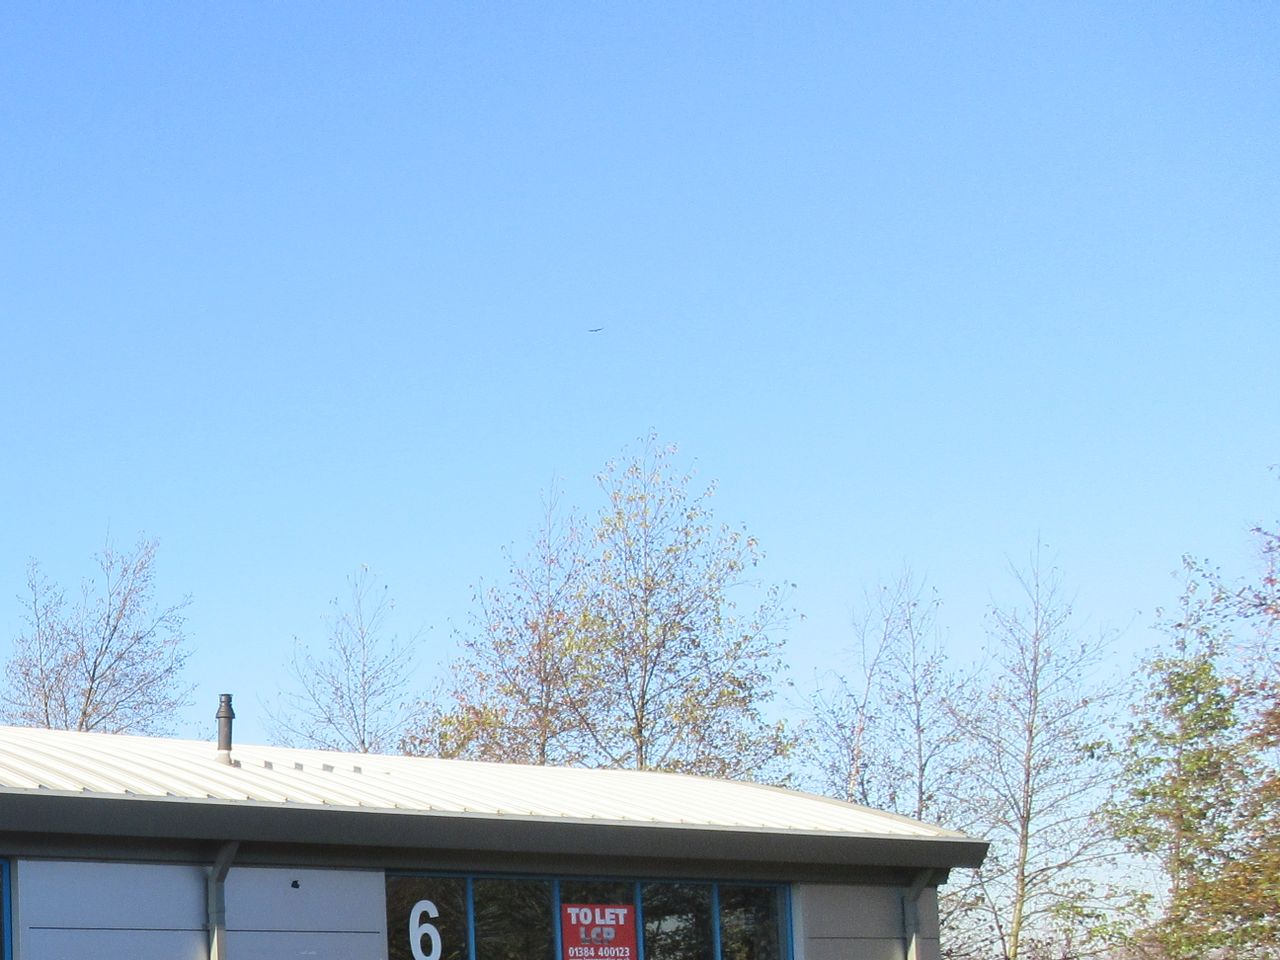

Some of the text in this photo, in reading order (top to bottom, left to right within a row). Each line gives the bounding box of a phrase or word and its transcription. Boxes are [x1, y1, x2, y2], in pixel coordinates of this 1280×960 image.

[567, 907, 628, 925] TO LET
[579, 926, 616, 945] LCP
[568, 946, 630, 957] 01384 400123
